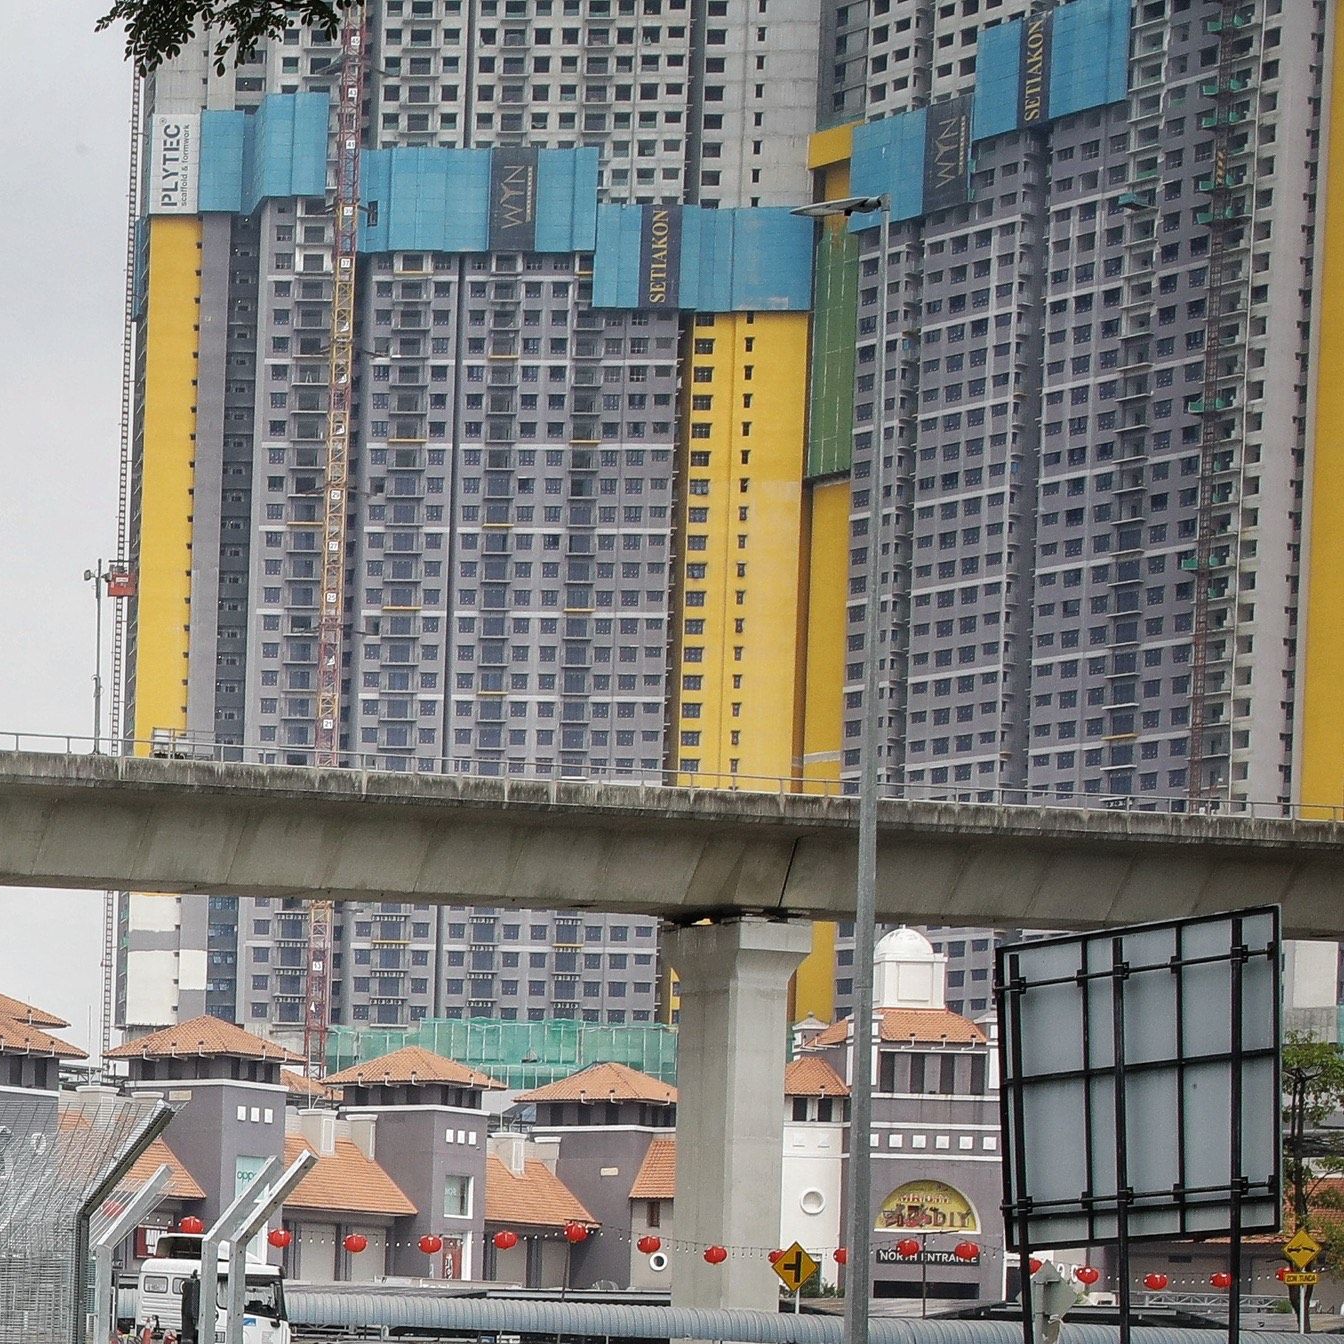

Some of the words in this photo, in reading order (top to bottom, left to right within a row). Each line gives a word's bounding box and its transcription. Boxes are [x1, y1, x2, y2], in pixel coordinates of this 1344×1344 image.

[1024, 18, 1045, 121] SETIAKON
[161, 124, 180, 207] PLYTEC
[934, 116, 959, 188] WYN
[181, 173, 189, 207] scaffold
[500, 165, 526, 230] WYN
[649, 210, 669, 303] SETIAKON
[237, 1170, 257, 1183] opp
